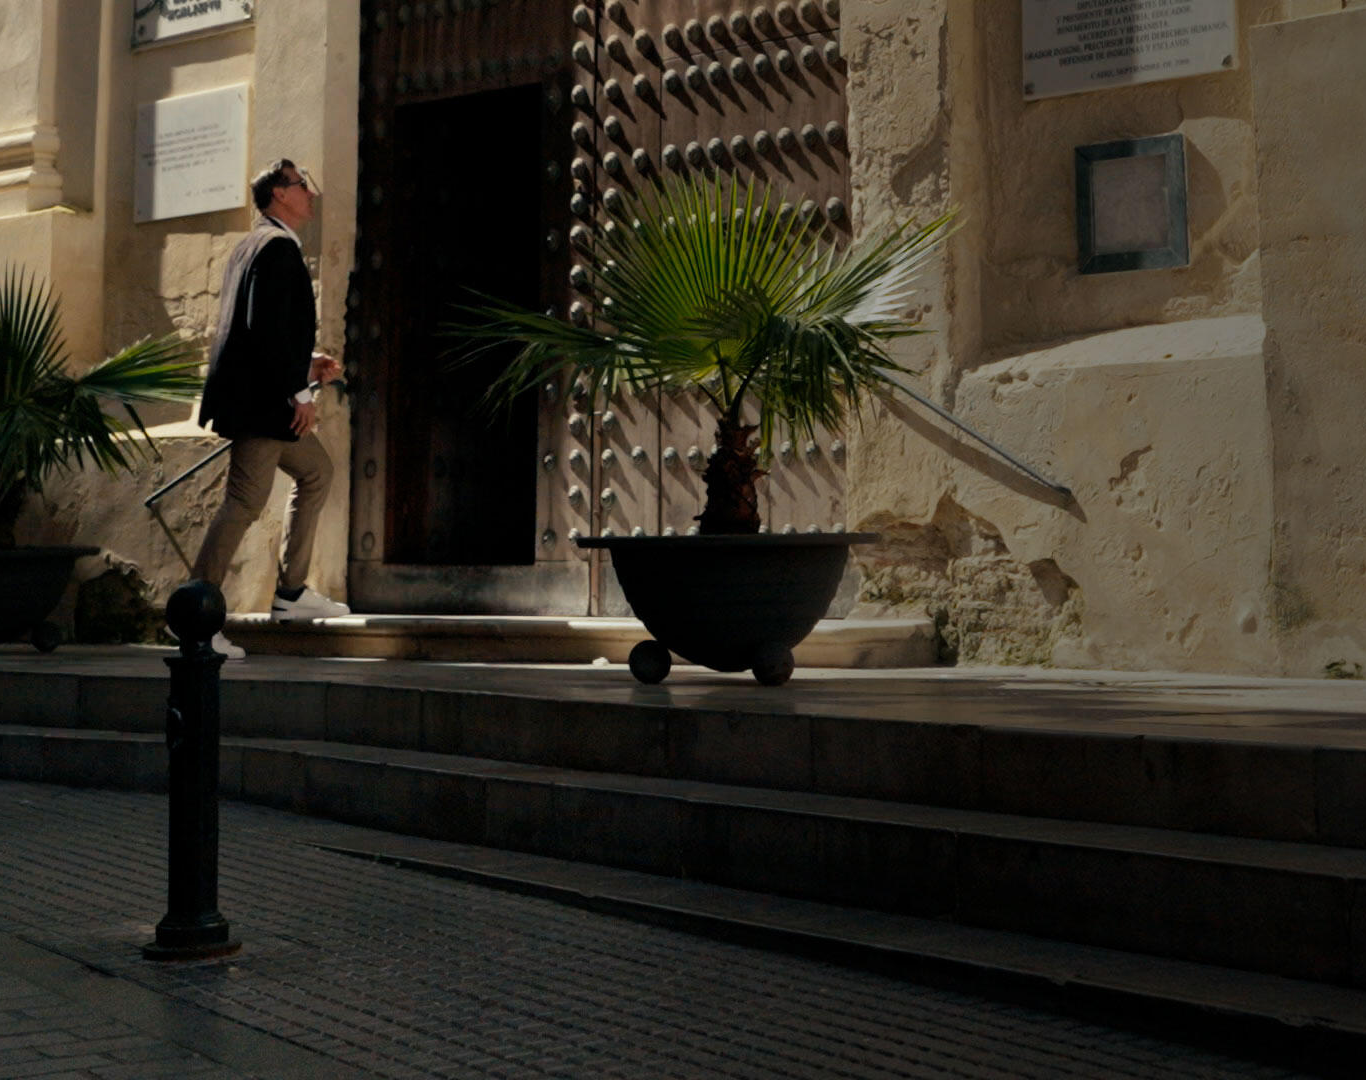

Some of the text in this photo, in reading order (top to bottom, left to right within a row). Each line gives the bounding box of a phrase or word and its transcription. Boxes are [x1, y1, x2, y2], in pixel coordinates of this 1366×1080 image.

[1062, 8, 1103, 24] PRESIDENTE
[1115, 4, 1128, 15] LAS
[1130, 0, 1157, 13] CORTES
[1112, 15, 1121, 26] LA
[1078, 26, 1118, 42] SACERDOTE
[1083, 37, 1122, 52] PRECURSOR
[1136, 32, 1149, 43] LOS
[1151, 26, 1187, 41] DERECHOS
[1059, 52, 1094, 66] DEFENSOR
[1116, 60, 1160, 76] SEPTIEMBRE
